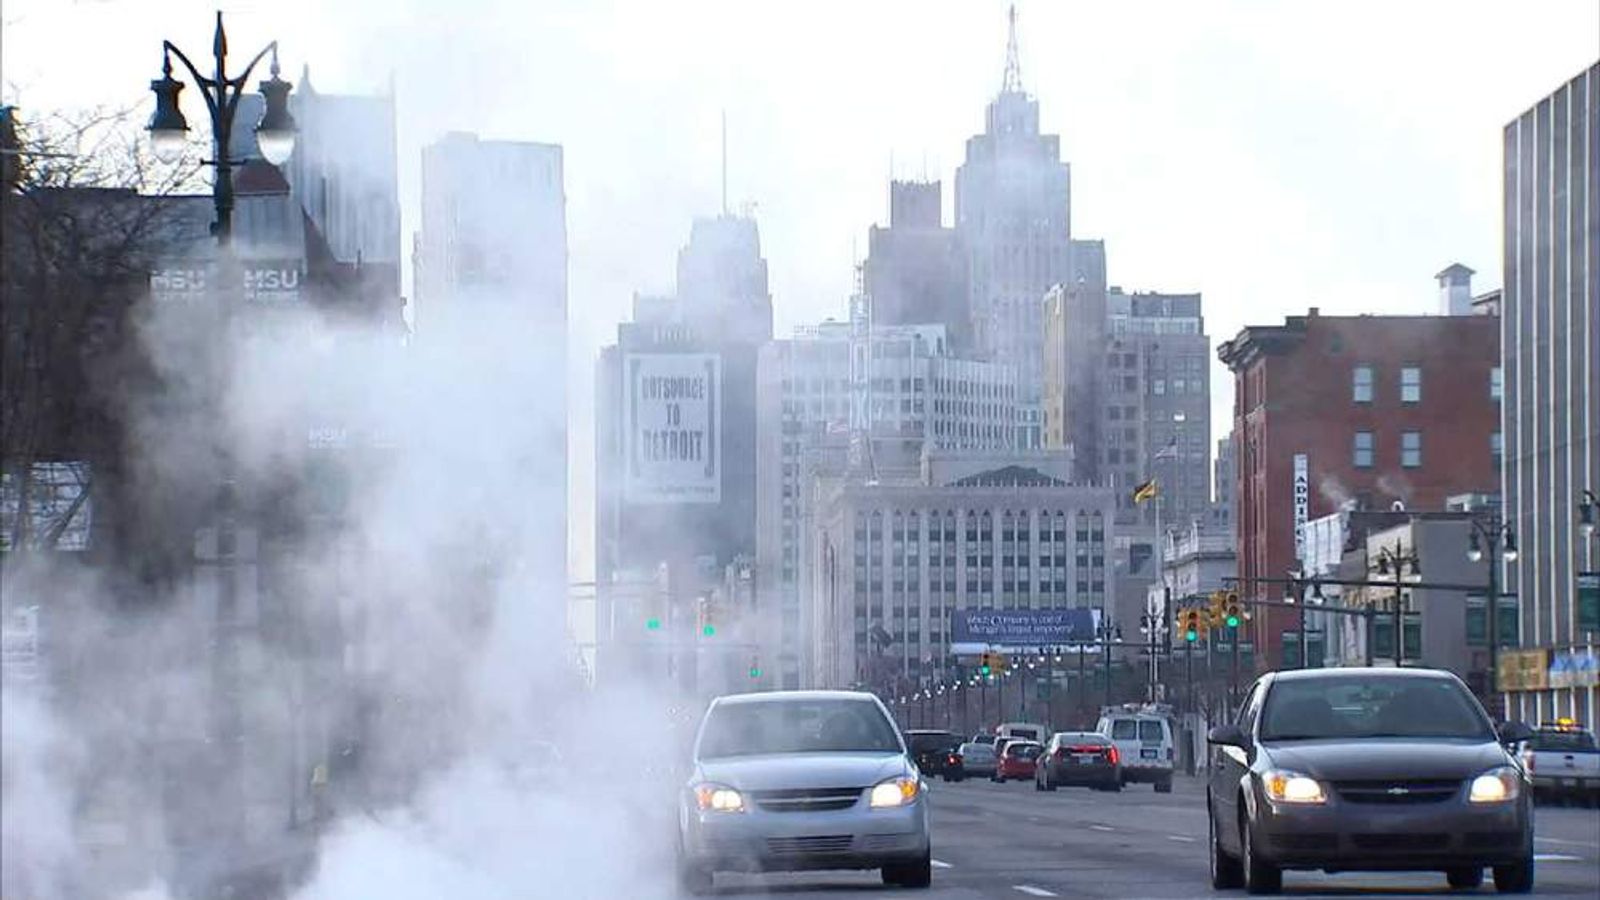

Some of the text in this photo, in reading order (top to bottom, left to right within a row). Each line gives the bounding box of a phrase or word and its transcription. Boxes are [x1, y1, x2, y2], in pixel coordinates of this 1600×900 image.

[151, 268, 206, 289] MSU
[243, 268, 298, 289] MSU
[641, 376, 704, 400] OUTSOURCE
[666, 403, 681, 426] TO
[641, 429, 704, 462] DETROIT
